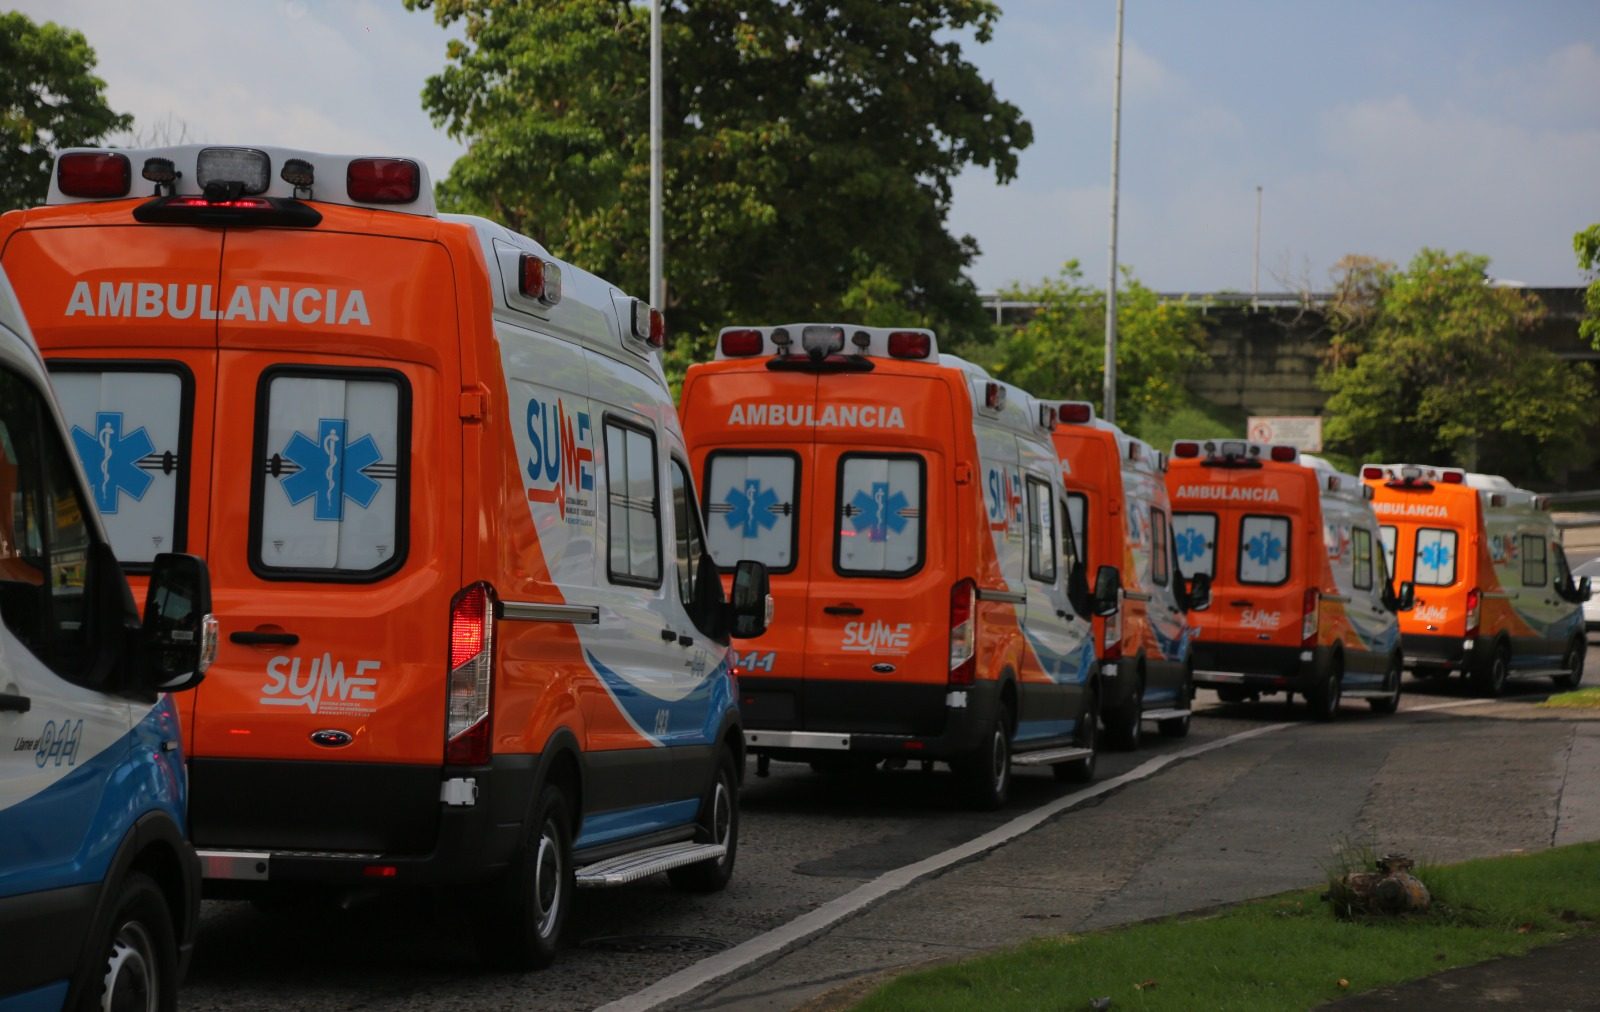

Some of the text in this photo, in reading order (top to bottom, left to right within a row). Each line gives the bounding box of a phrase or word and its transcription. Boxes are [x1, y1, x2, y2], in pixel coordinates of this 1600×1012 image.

[65, 281, 371, 326] AMBULANCIA
[728, 404, 905, 428] AMBULANCIA
[526, 398, 594, 508] SUME
[1176, 485, 1280, 502] AMBULANCIA
[1371, 502, 1449, 518] MBULANCIA
[841, 619, 912, 652] SUME
[735, 650, 778, 673] -1-1
[260, 652, 381, 709] SUME
